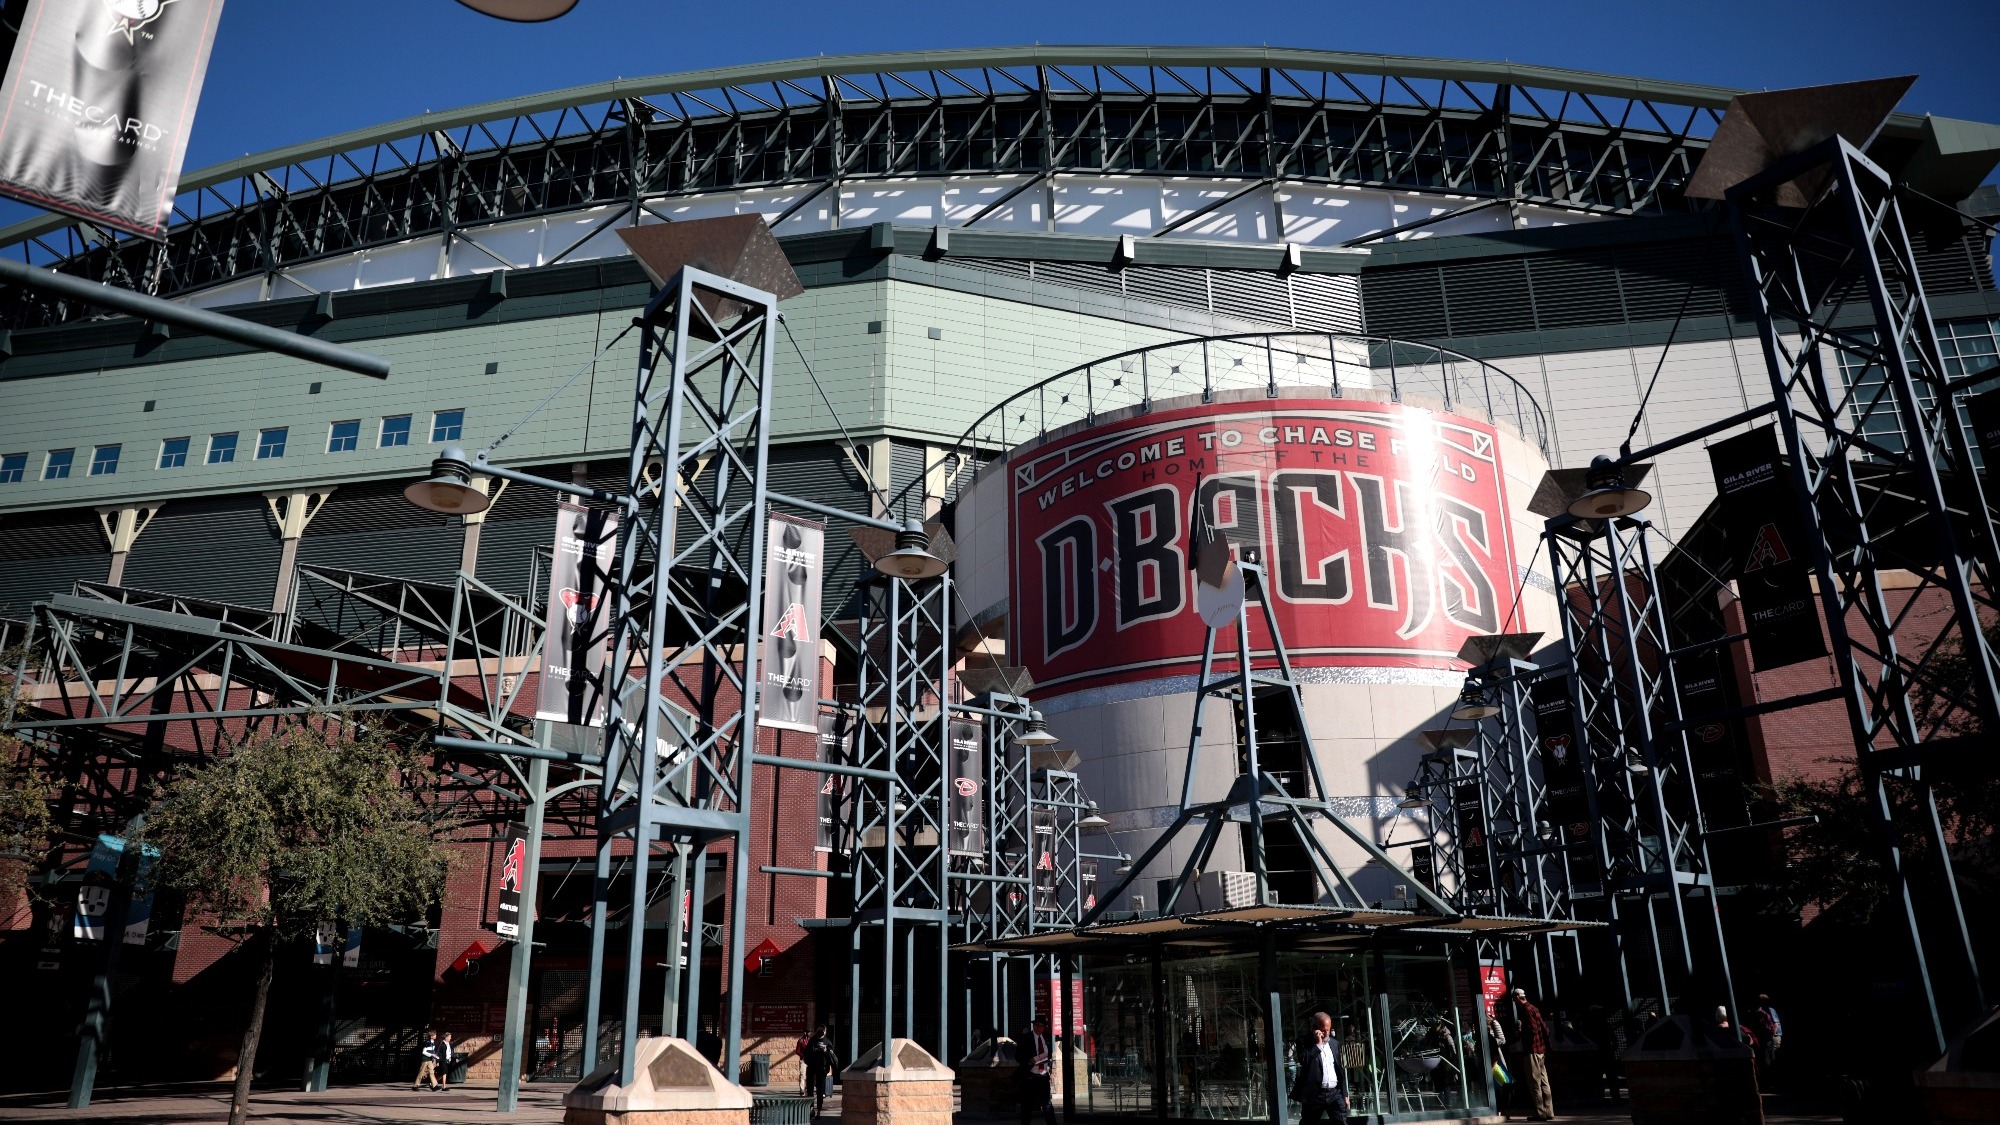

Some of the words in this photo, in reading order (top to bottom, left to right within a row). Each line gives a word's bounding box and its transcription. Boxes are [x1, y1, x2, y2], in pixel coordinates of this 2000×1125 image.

[1037, 436, 1186, 513] WELCOME
[1198, 429, 1243, 451] TO
[1258, 426, 1376, 450] CHASE
[1389, 437, 1477, 483] FLD
[1142, 454, 1225, 482] HOME
[1311, 451, 1369, 468] THE
